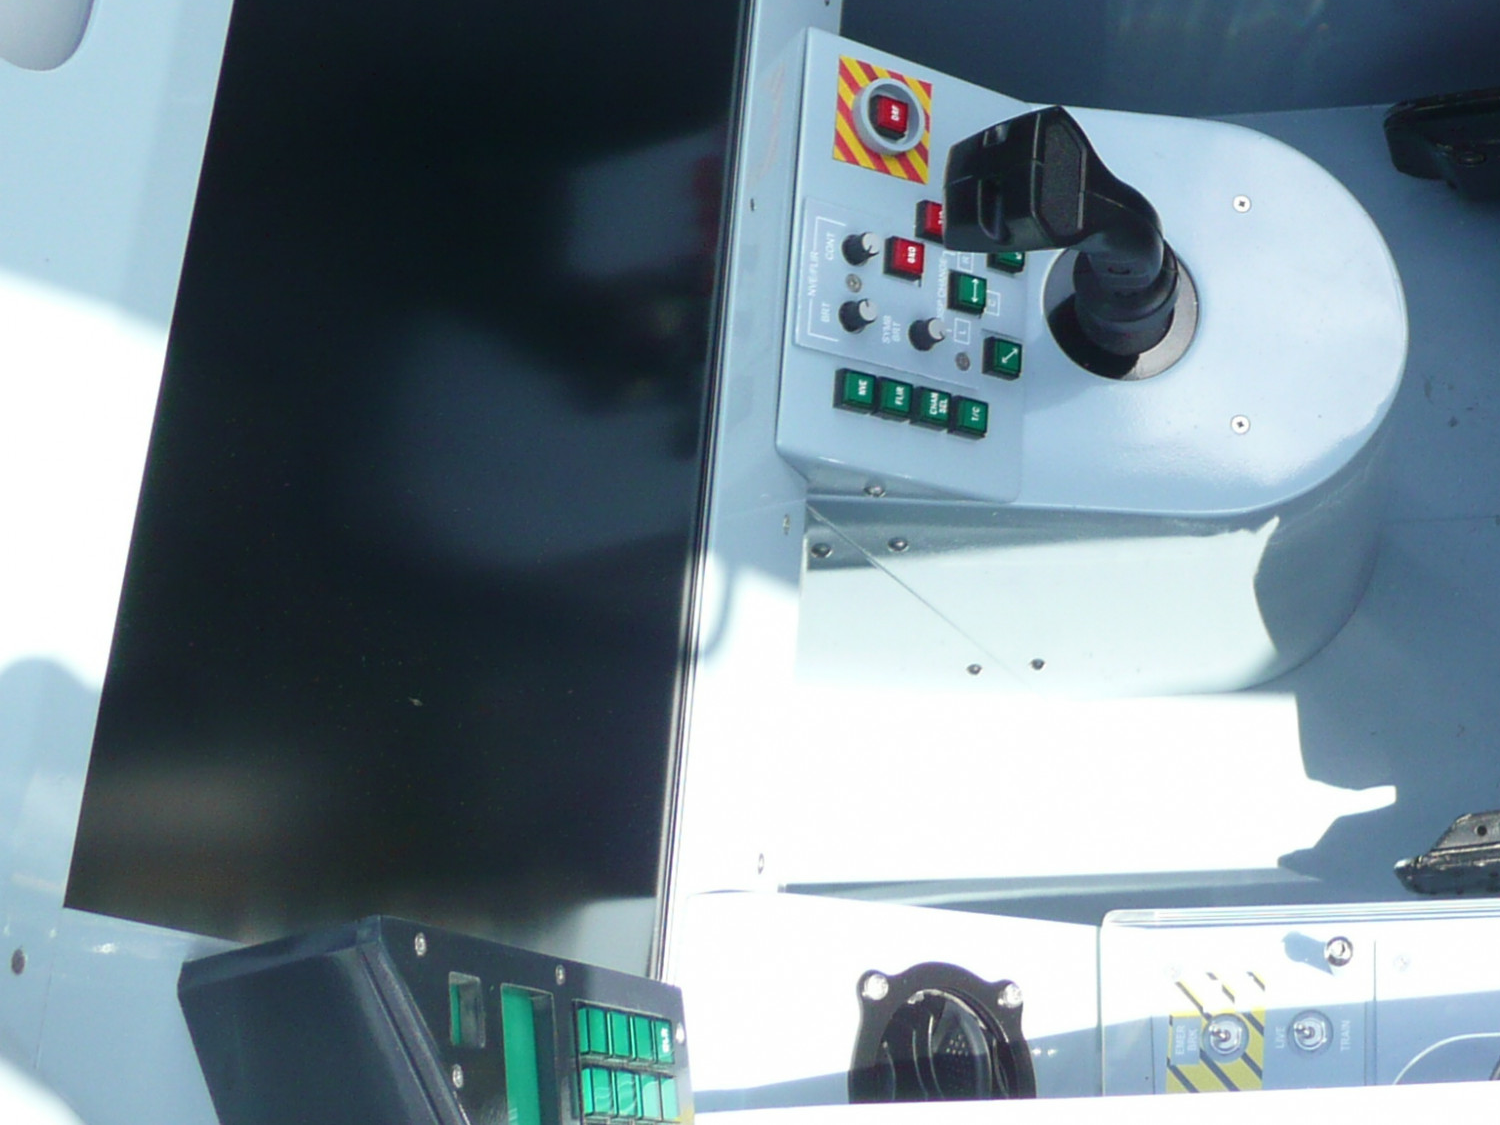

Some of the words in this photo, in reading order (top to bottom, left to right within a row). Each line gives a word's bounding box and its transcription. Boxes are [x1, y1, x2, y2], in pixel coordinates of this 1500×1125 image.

[825, 232, 836, 260] CONT
[821, 302, 831, 322] BRT
[894, 388, 903, 404] FLIR
[930, 393, 939, 414] CHAN
[939, 399, 947, 413] SEL
[1175, 1025, 1185, 1054] EMER
[1187, 1029, 1198, 1051] BRK
[1275, 1027, 1285, 1048] LIVE
[1340, 1020, 1351, 1051] TRAIN
